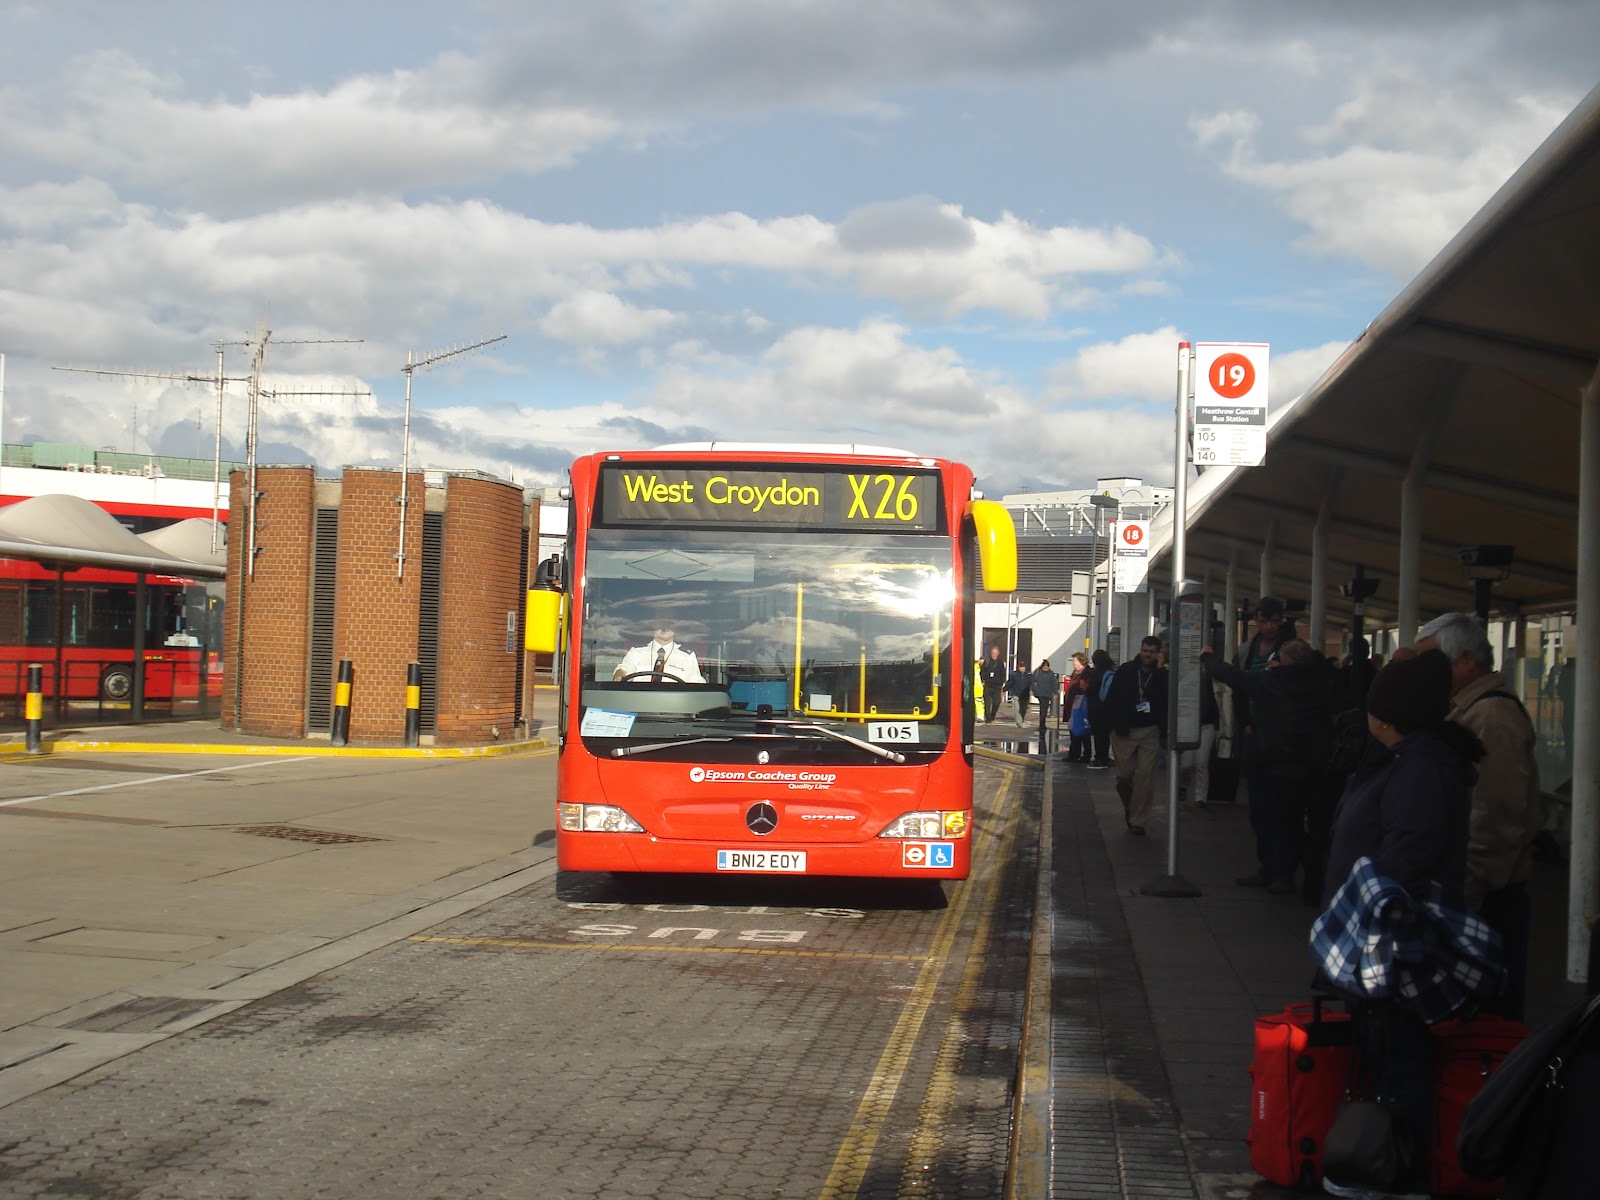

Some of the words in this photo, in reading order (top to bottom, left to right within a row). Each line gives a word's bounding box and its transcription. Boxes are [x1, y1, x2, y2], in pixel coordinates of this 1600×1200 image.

[1218, 364, 1246, 387] 19
[1201, 407, 1234, 416] Heathrow
[1235, 408, 1260, 416] Central
[1225, 415, 1249, 423] Station
[1197, 432, 1216, 442] 105
[1197, 451, 1216, 461] 140
[624, 475, 694, 503] West
[705, 476, 819, 513] Croydon
[847, 474, 918, 521] X26
[1126, 530, 1140, 541] 18
[875, 725, 912, 740] 105
[705, 769, 745, 781] Epsom
[747, 771, 797, 781] Coaches
[799, 772, 837, 784] Group
[731, 853, 765, 868] BN12
[770, 854, 800, 869] EOY
